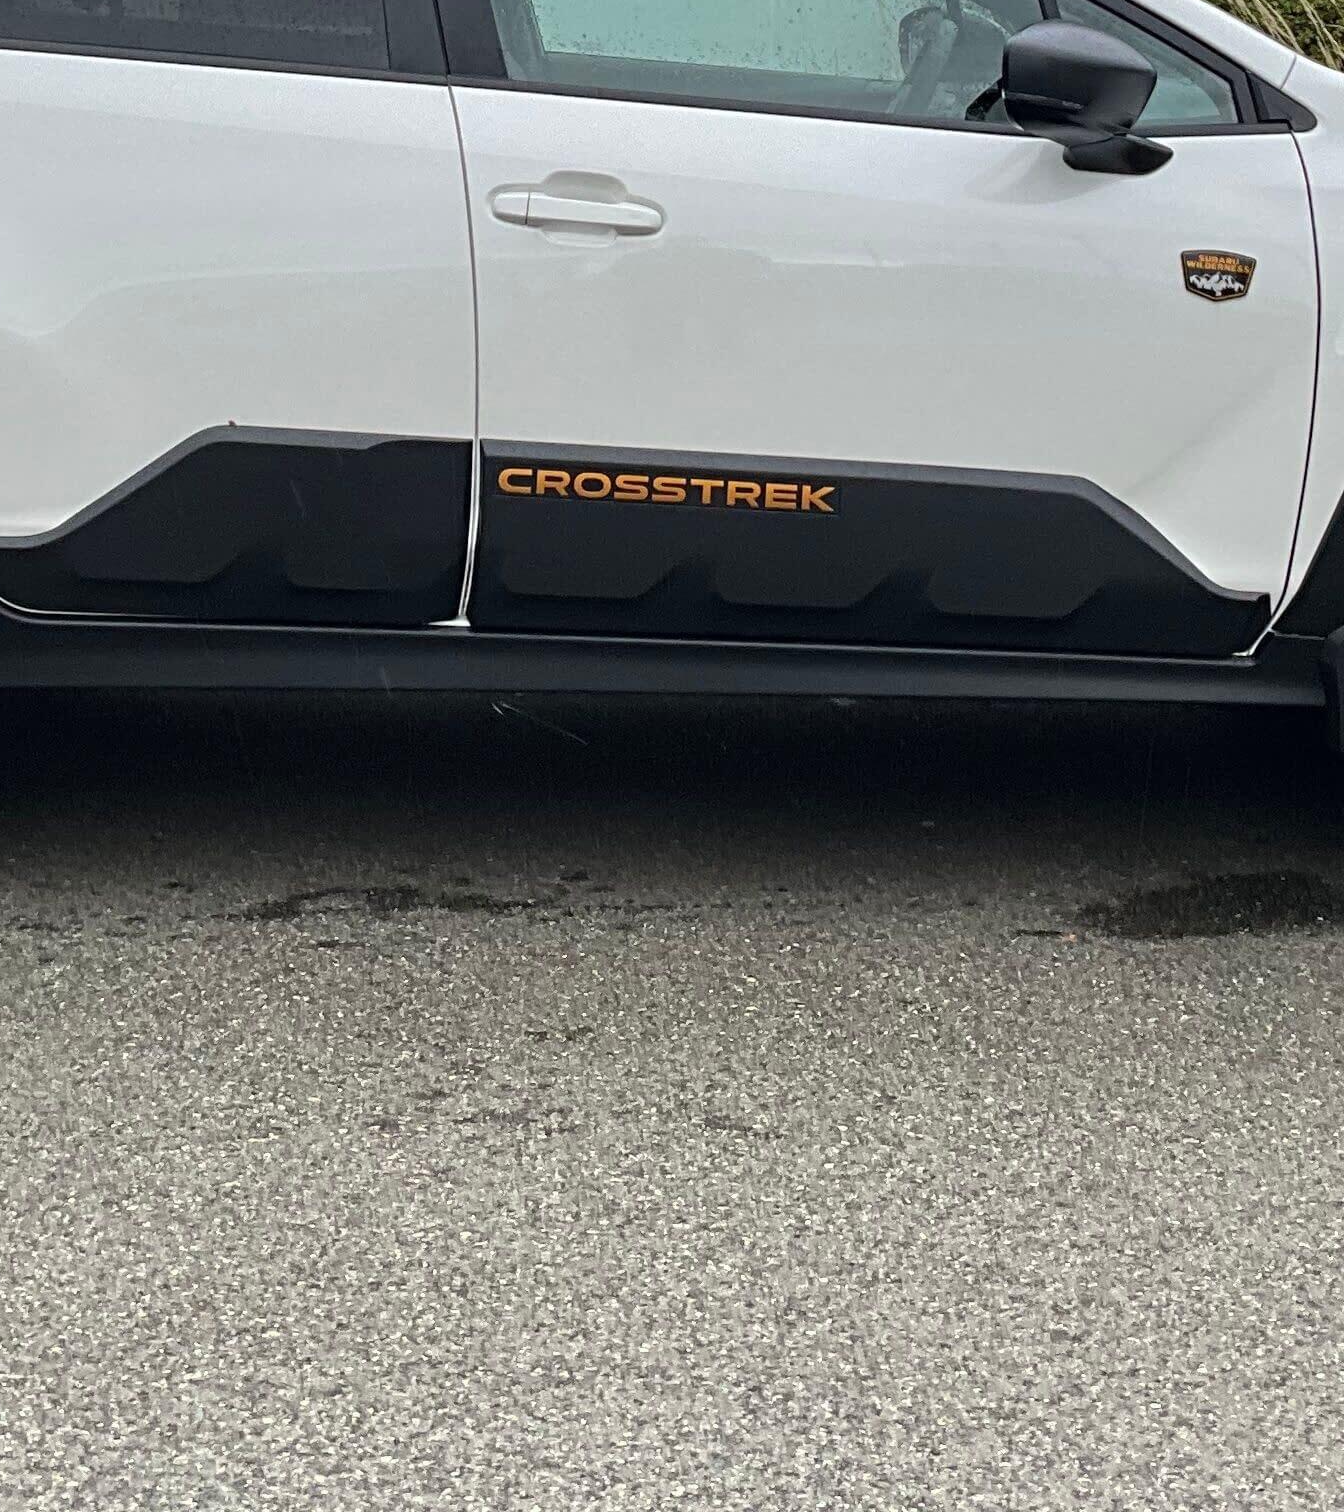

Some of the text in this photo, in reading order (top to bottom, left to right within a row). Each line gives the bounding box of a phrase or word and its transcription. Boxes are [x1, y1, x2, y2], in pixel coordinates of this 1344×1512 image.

[1199, 254, 1240, 265] SUBARU
[1186, 260, 1251, 274] WILDERNESS
[498, 468, 836, 513] CROSSTREK
